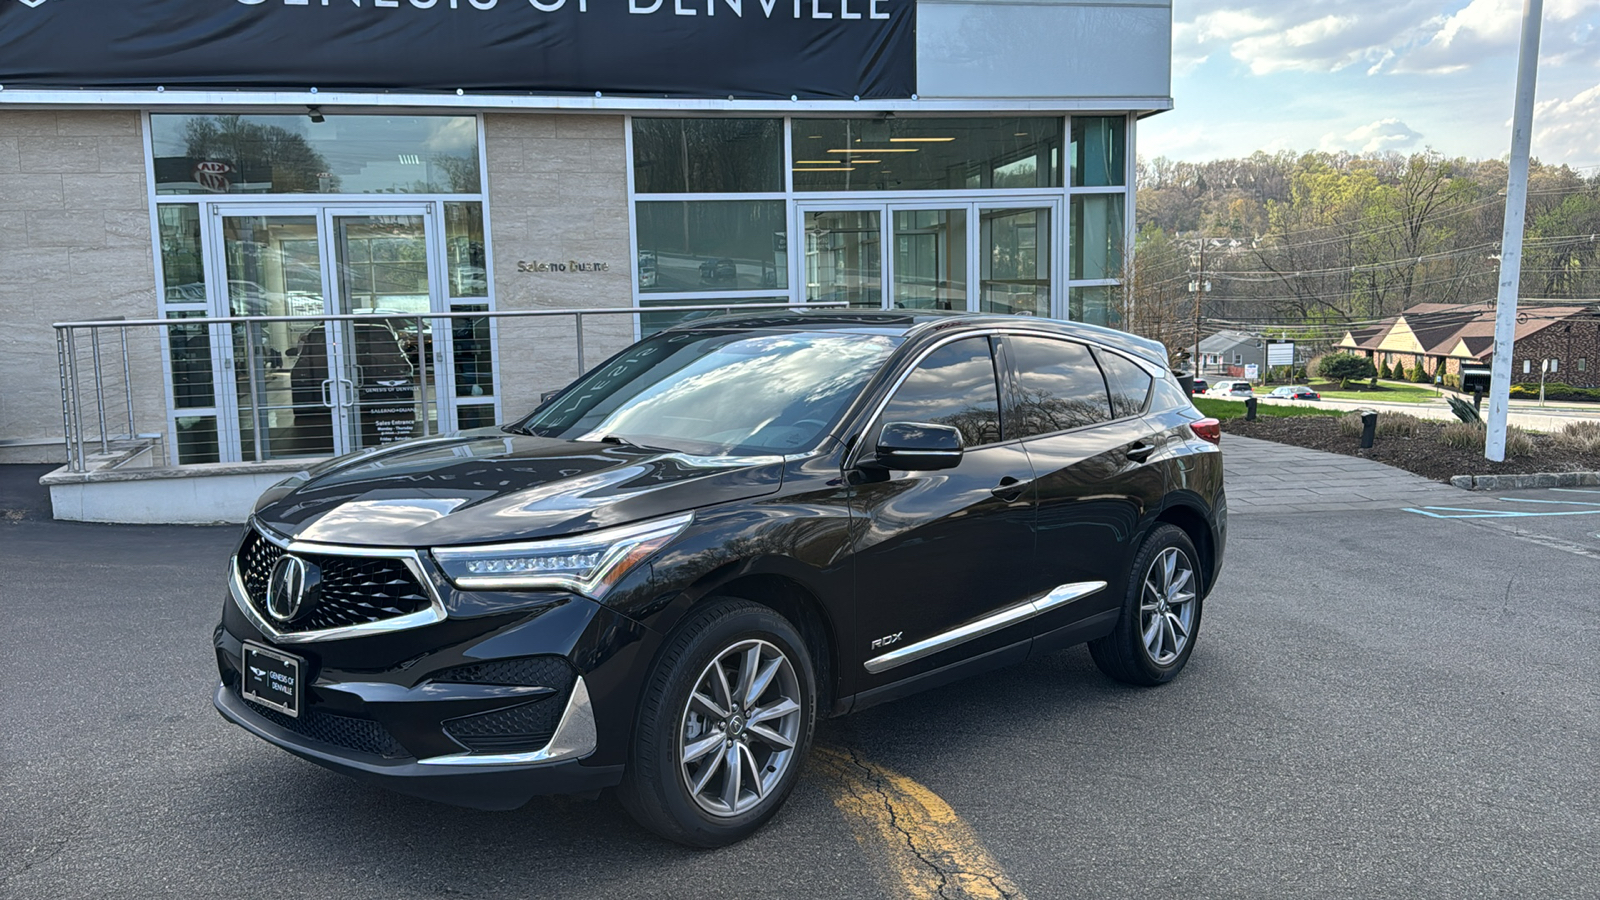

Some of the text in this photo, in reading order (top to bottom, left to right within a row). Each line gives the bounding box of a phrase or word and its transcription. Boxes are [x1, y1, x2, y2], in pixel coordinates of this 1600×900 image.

[871, 631, 903, 650] RDX
[270, 671, 287, 683] GENESIS
[288, 677, 294, 686] OF
[272, 682, 292, 696] DENVILLE
